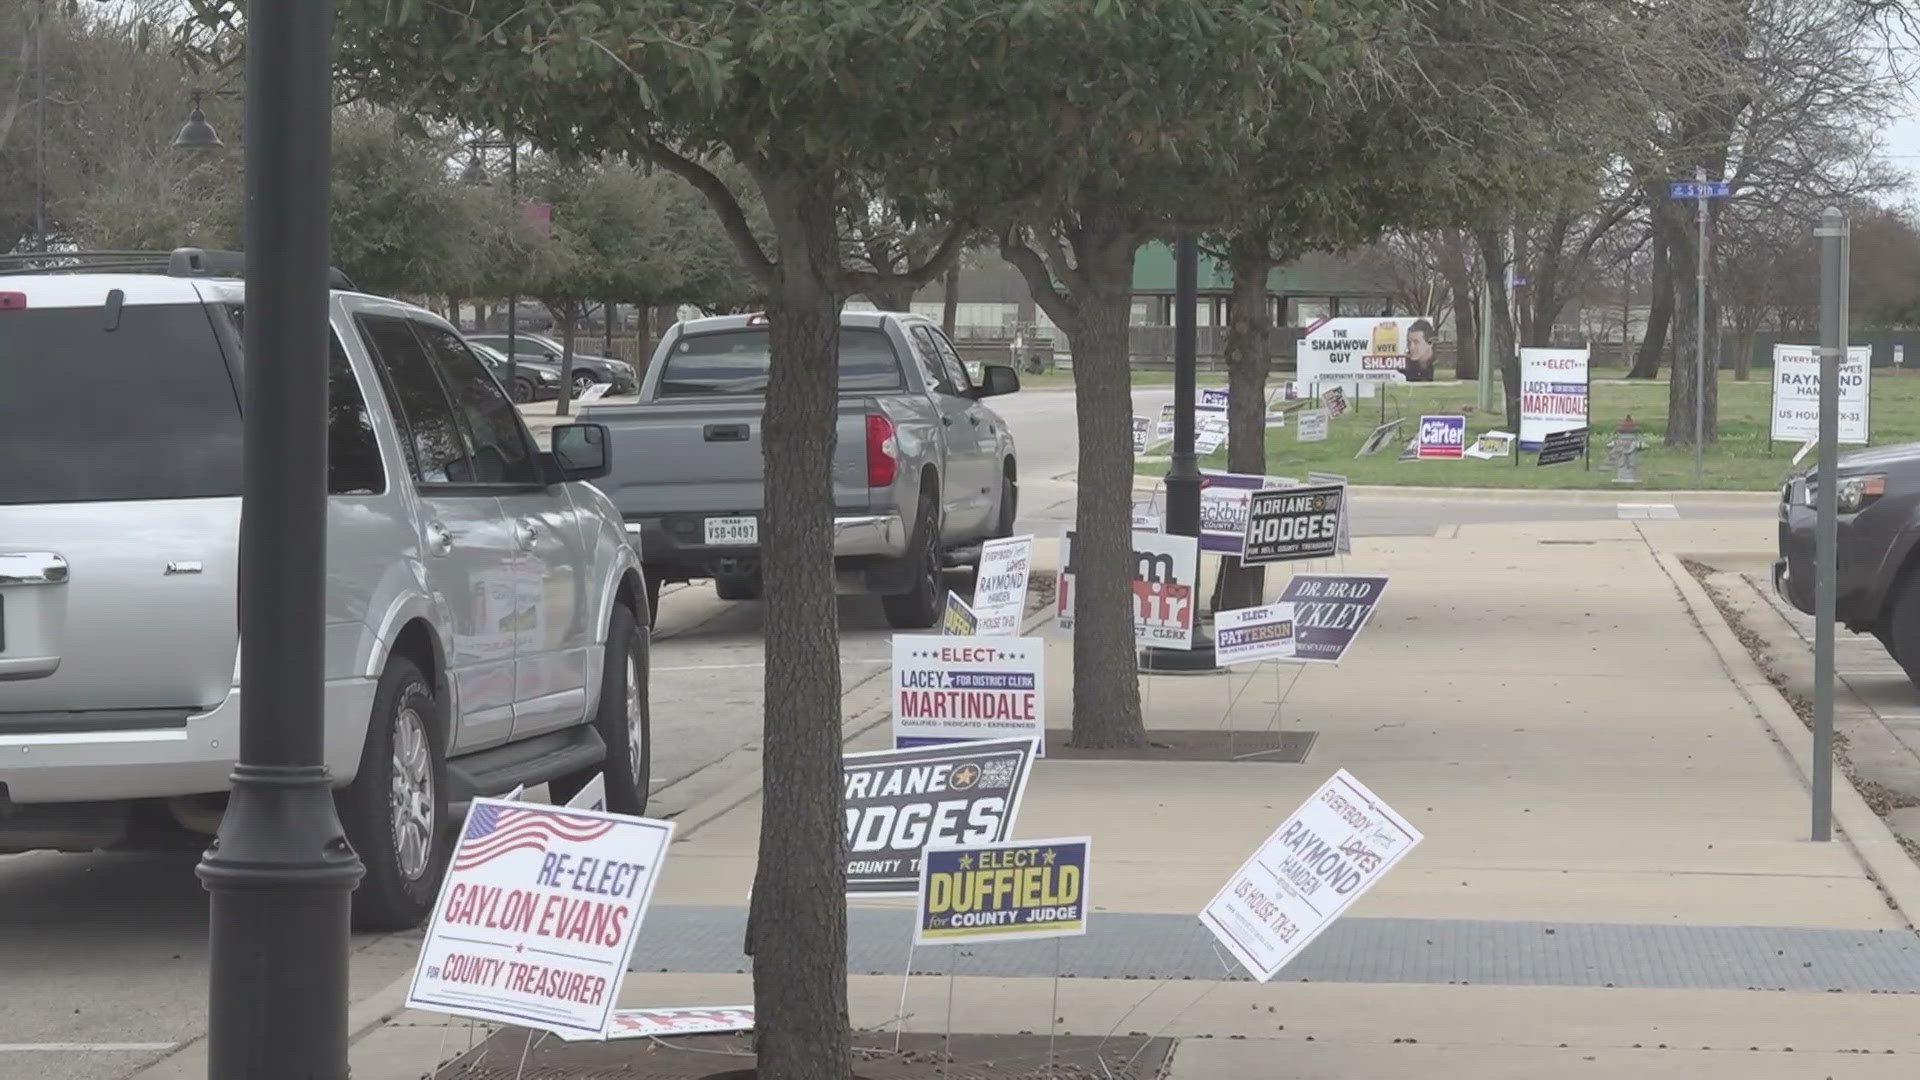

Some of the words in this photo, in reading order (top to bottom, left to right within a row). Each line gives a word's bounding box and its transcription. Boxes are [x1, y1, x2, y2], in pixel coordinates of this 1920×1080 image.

[1687, 185, 1694, 196] S
[1332, 329, 1347, 338] THE
[1311, 340, 1368, 350] SHAMWOW
[1376, 344, 1396, 352] VOTE
[1329, 354, 1350, 363] GUY
[1364, 357, 1406, 369] SHLOMI
[1547, 359, 1575, 370] ELECT
[1523, 381, 1548, 394] LACEY
[1781, 373, 1863, 387] RAYMND
[1797, 386, 1847, 396] HAMN
[1523, 395, 1588, 415] MARTINDALE
[1779, 410, 1792, 419] US
[1840, 412, 1860, 421] X-31
[1421, 423, 1463, 444] Carter
[1253, 497, 1314, 515] ADRIANE
[708, 525, 755, 539] VSB-0497
[1250, 513, 1336, 544] HODGES
[979, 572, 1024, 593] RAYMOND
[1296, 581, 1321, 597] DR.
[1324, 582, 1371, 599] BRAD
[1242, 609, 1269, 621] ELECT
[1294, 602, 1372, 630] CKLEY
[1152, 629, 1186, 640] CLERK
[1220, 622, 1291, 646] PATTERSON
[942, 647, 997, 662] ELECT
[901, 670, 944, 689] LACEY
[955, 675, 970, 686] FOR
[972, 675, 1006, 687] DISTRICT
[1008, 676, 1033, 687] CLERK
[900, 691, 1036, 720] MARTINDALE
[987, 721, 1036, 729] EXPERIENCED
[844, 764, 953, 800] RIANE
[1320, 788, 1375, 832] EVERYBODY
[846, 797, 1005, 852] DGES
[979, 849, 1040, 869] ELECT
[1279, 820, 1362, 895] RAYMOND
[1338, 834, 1383, 875] LOVES
[536, 850, 647, 899] RE-ELECT
[847, 859, 901, 874] COUNTY
[1277, 855, 1323, 897] HAMDEN
[929, 864, 1080, 914] DUFFIELD
[444, 883, 542, 934] GAYLON
[537, 894, 630, 949] EVANS
[928, 913, 948, 929] for
[950, 910, 1018, 927] COUNTY
[1026, 906, 1077, 922] JUDGE
[1234, 877, 1254, 899] US
[1244, 886, 1280, 923] HOUSE
[1273, 911, 1301, 944] TX-31
[425, 965, 440, 980] FOR
[442, 953, 506, 987] COUNTY
[503, 962, 607, 1006] TREASURER
